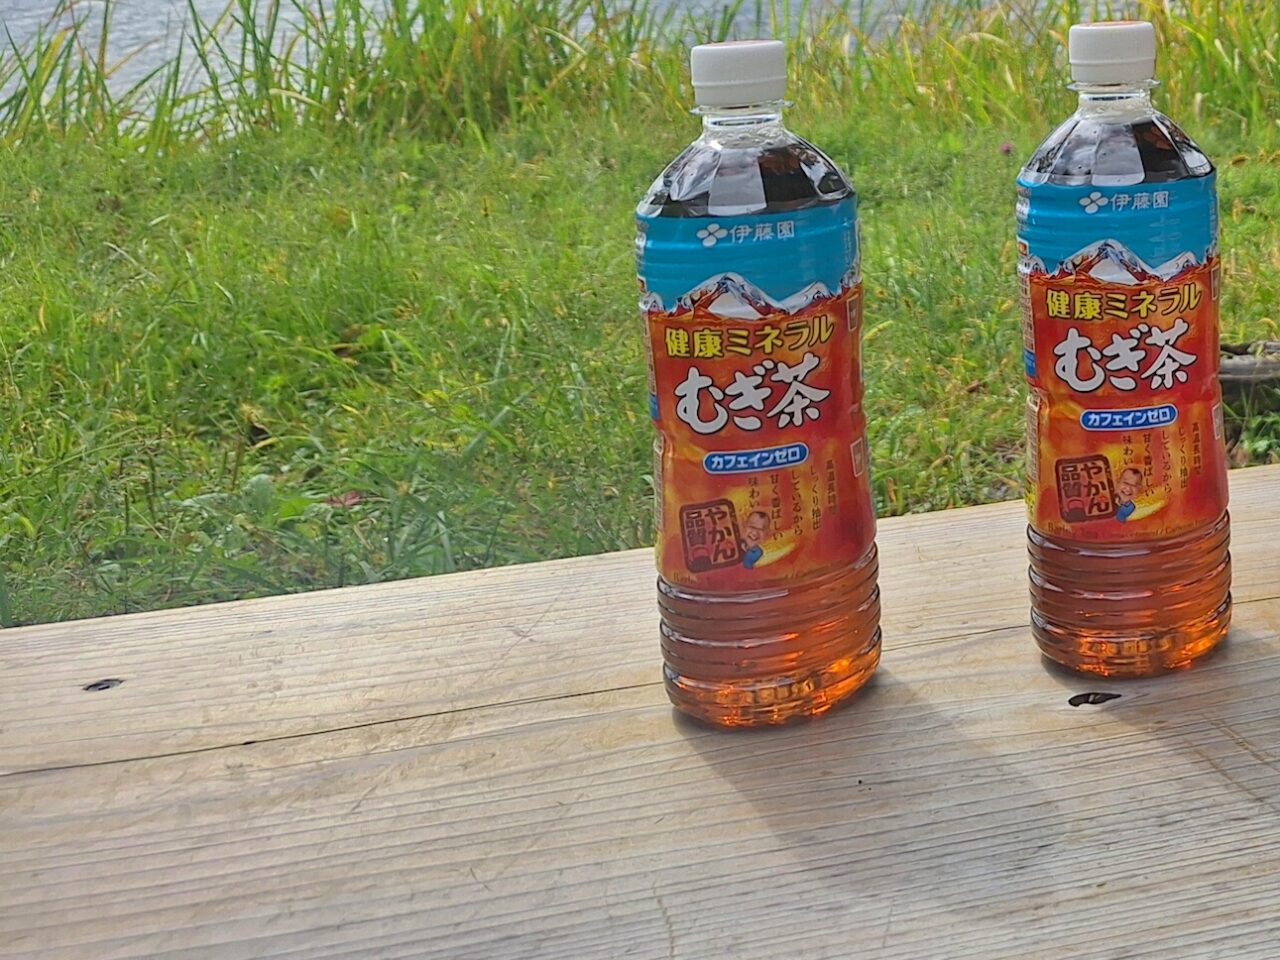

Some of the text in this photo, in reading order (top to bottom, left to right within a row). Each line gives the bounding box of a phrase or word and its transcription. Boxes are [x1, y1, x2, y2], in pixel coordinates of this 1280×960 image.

[1110, 190, 1169, 211] 伊藤園
[729, 220, 794, 243] 伊藤園
[1046, 283, 1201, 320] 健康ミネラル
[665, 315, 833, 358] 健康ミネラル
[1053, 318, 1198, 393] むぎ茶
[674, 352, 830, 435] むぎ茶
[1088, 405, 1171, 427] カフェインゼロ
[711, 445, 800, 471] カフェインゼロ
[1081, 462, 1109, 514] やかん
[705, 507, 736, 562] やかん
